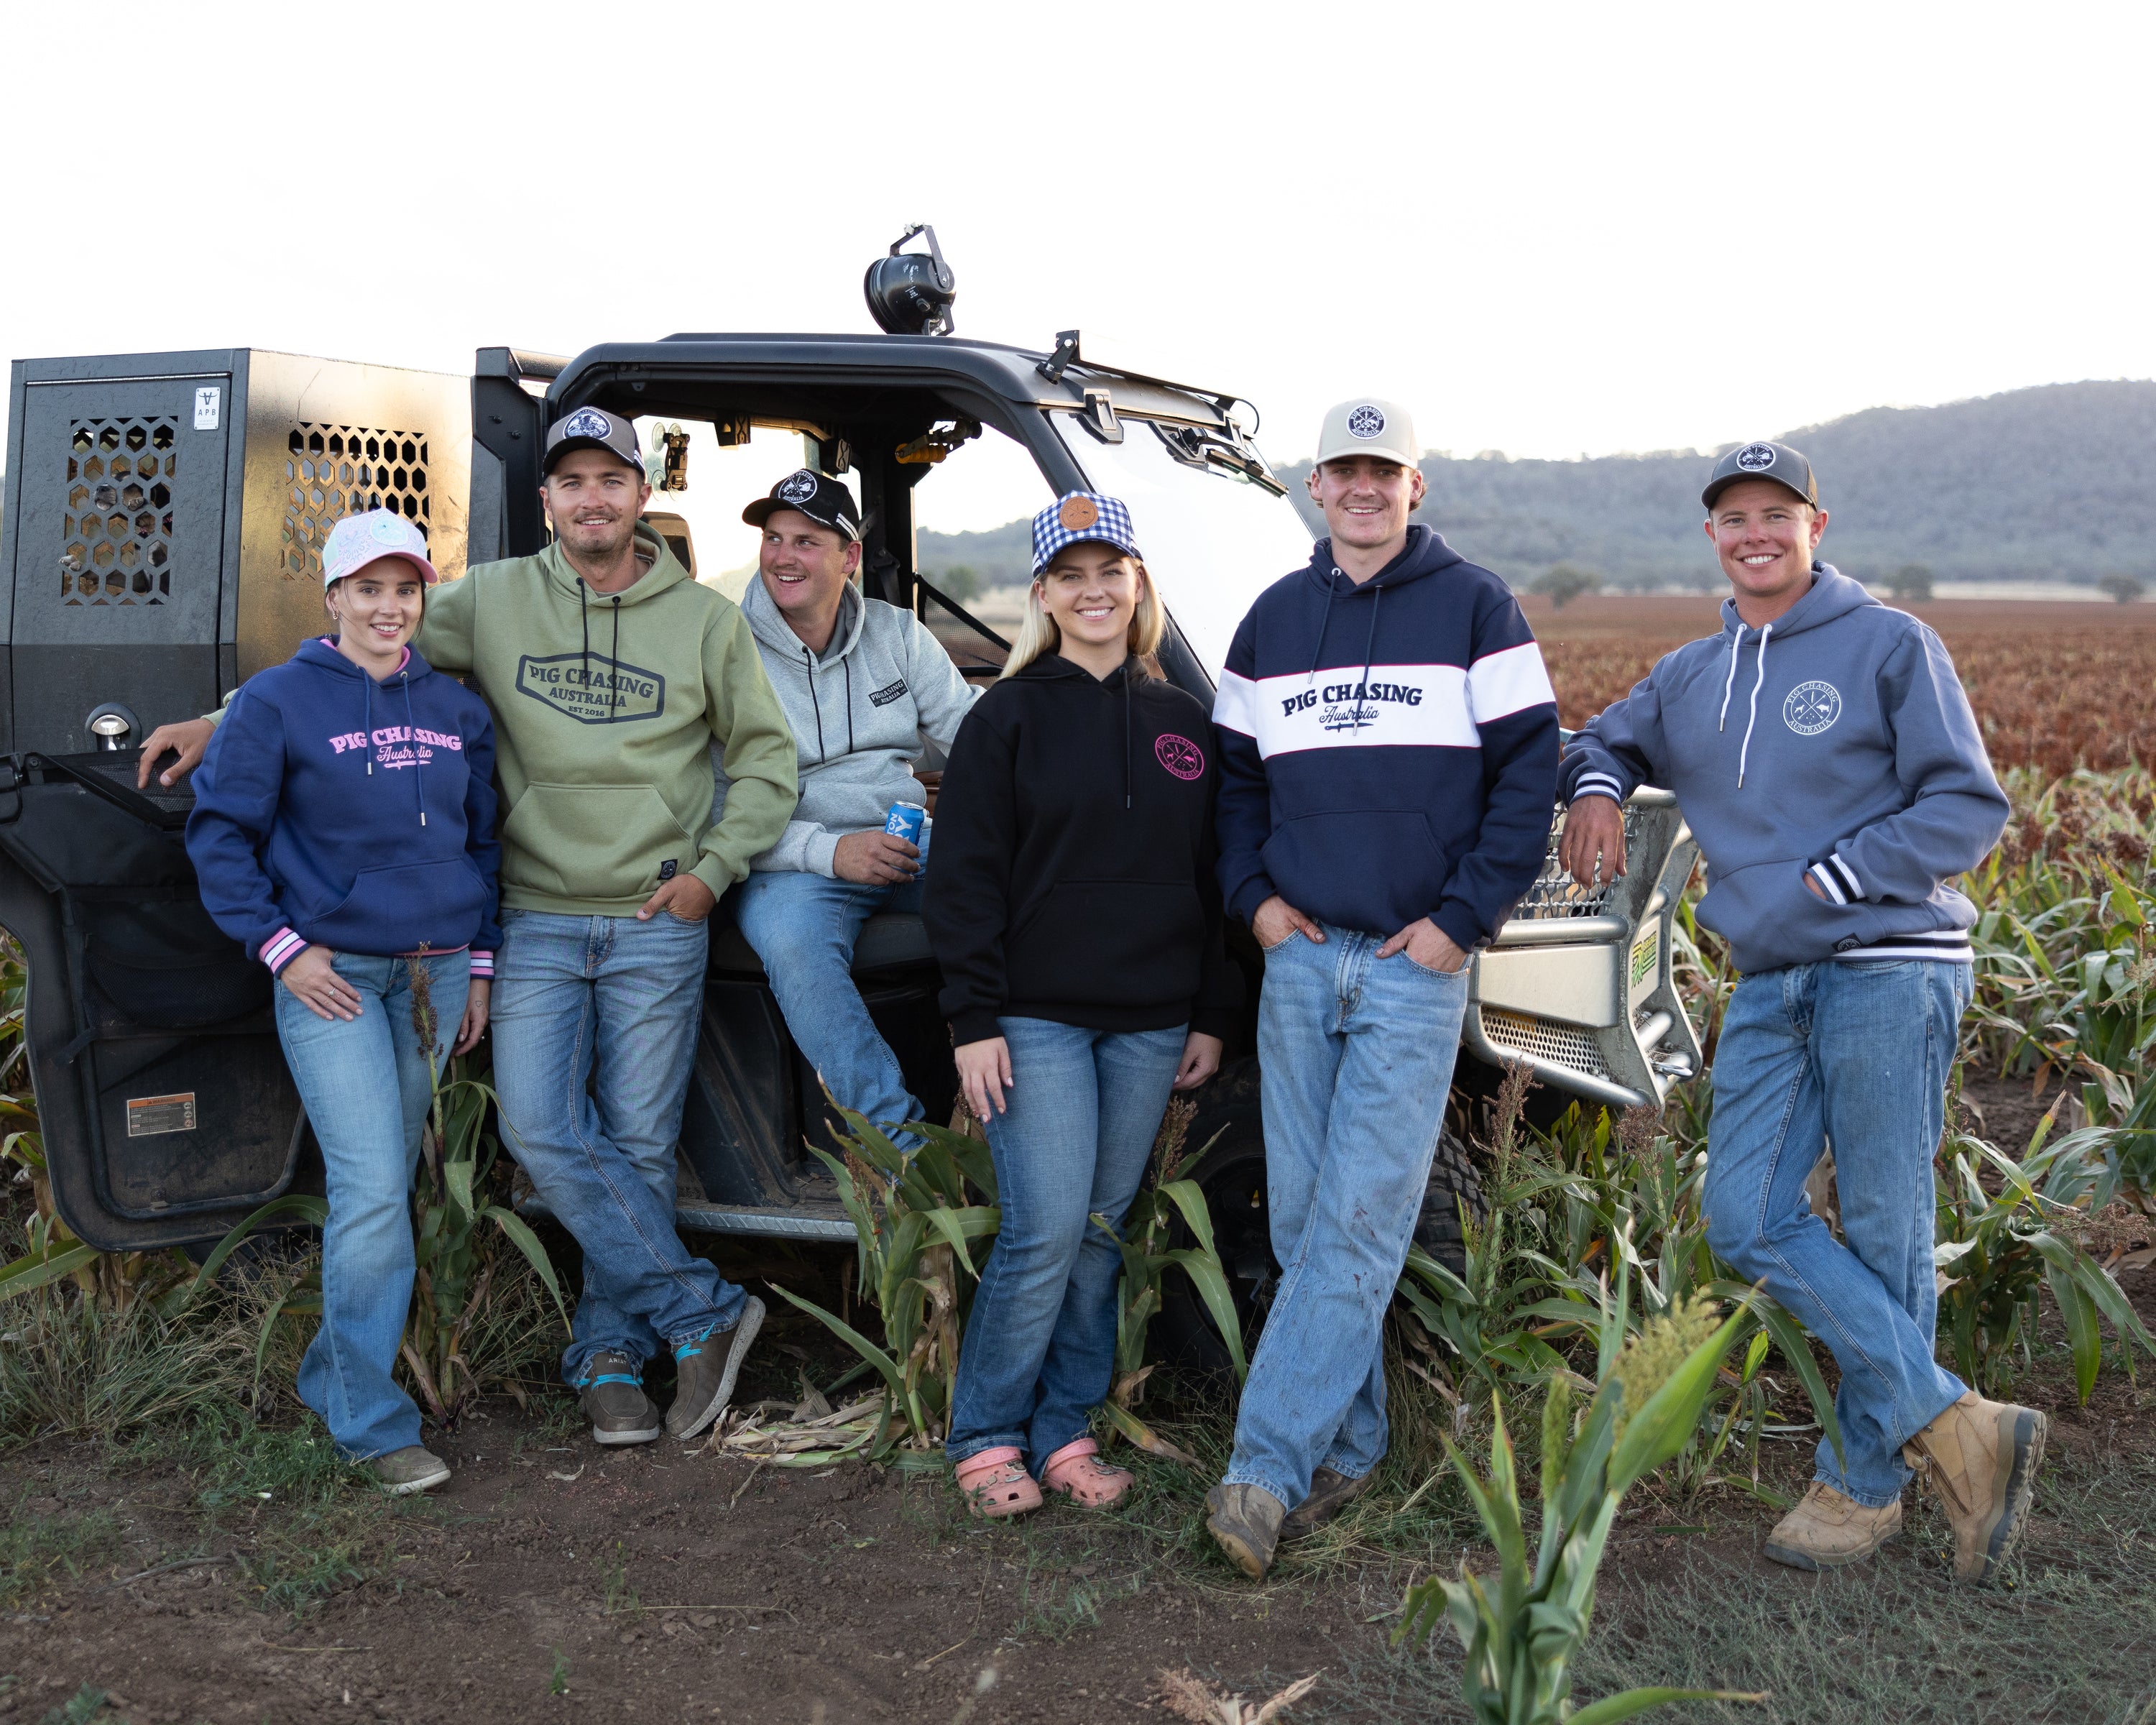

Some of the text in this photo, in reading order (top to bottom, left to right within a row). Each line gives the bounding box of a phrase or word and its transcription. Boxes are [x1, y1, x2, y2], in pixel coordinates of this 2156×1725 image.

[529, 665, 654, 698] PIG CHASING
[880, 681, 903, 697] HASING
[548, 687, 627, 707] AUSTRALA
[1281, 682, 1423, 717] PIG CHASING
[1787, 683, 1838, 703] PIG CHASING
[585, 707, 605, 717] 2016
[1319, 705, 1380, 723] Australia
[1788, 719, 1832, 732] AUSTRALIA
[329, 726, 462, 754] PIG CHASING
[1165, 736, 1199, 756] CHASING
[1166, 763, 1199, 778] AUSTRALIA
